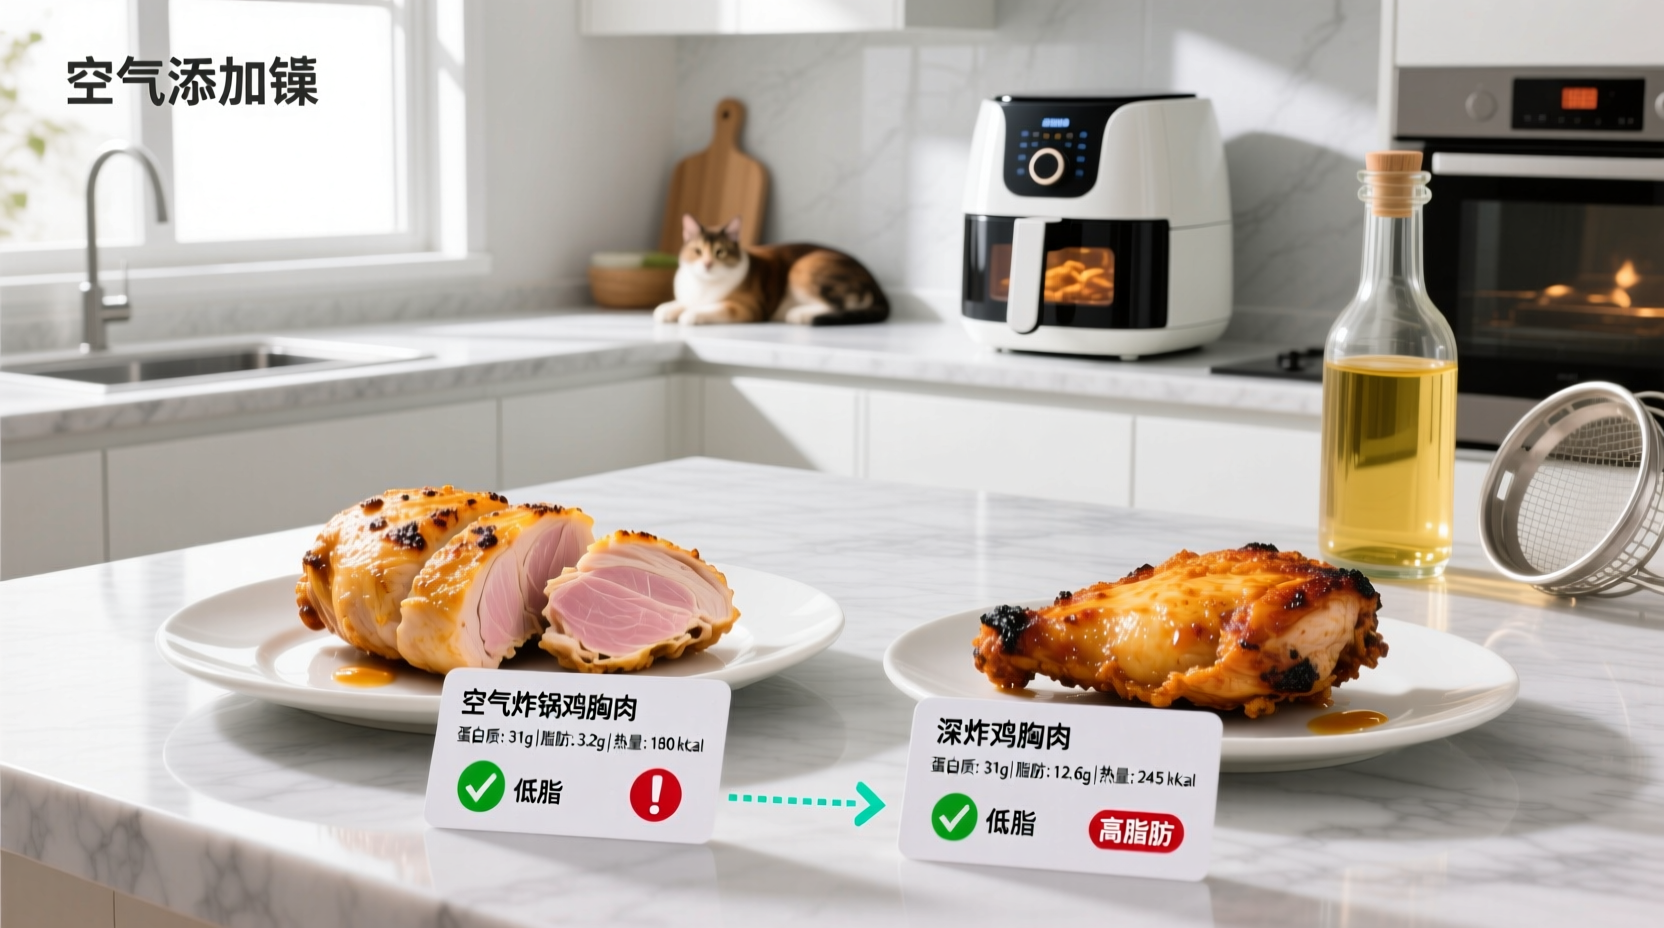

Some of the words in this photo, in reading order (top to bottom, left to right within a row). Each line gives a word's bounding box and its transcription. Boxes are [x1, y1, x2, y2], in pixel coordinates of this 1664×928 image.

[461, 687, 638, 722] 空气炸锅鸡胸肉
[936, 717, 1071, 751] 深炸鸡胸肉
[513, 777, 564, 805] 低脂
[1138, 769, 1164, 785] 245
[985, 807, 1037, 837] 低脂
[1099, 816, 1175, 848] 高脂肪
